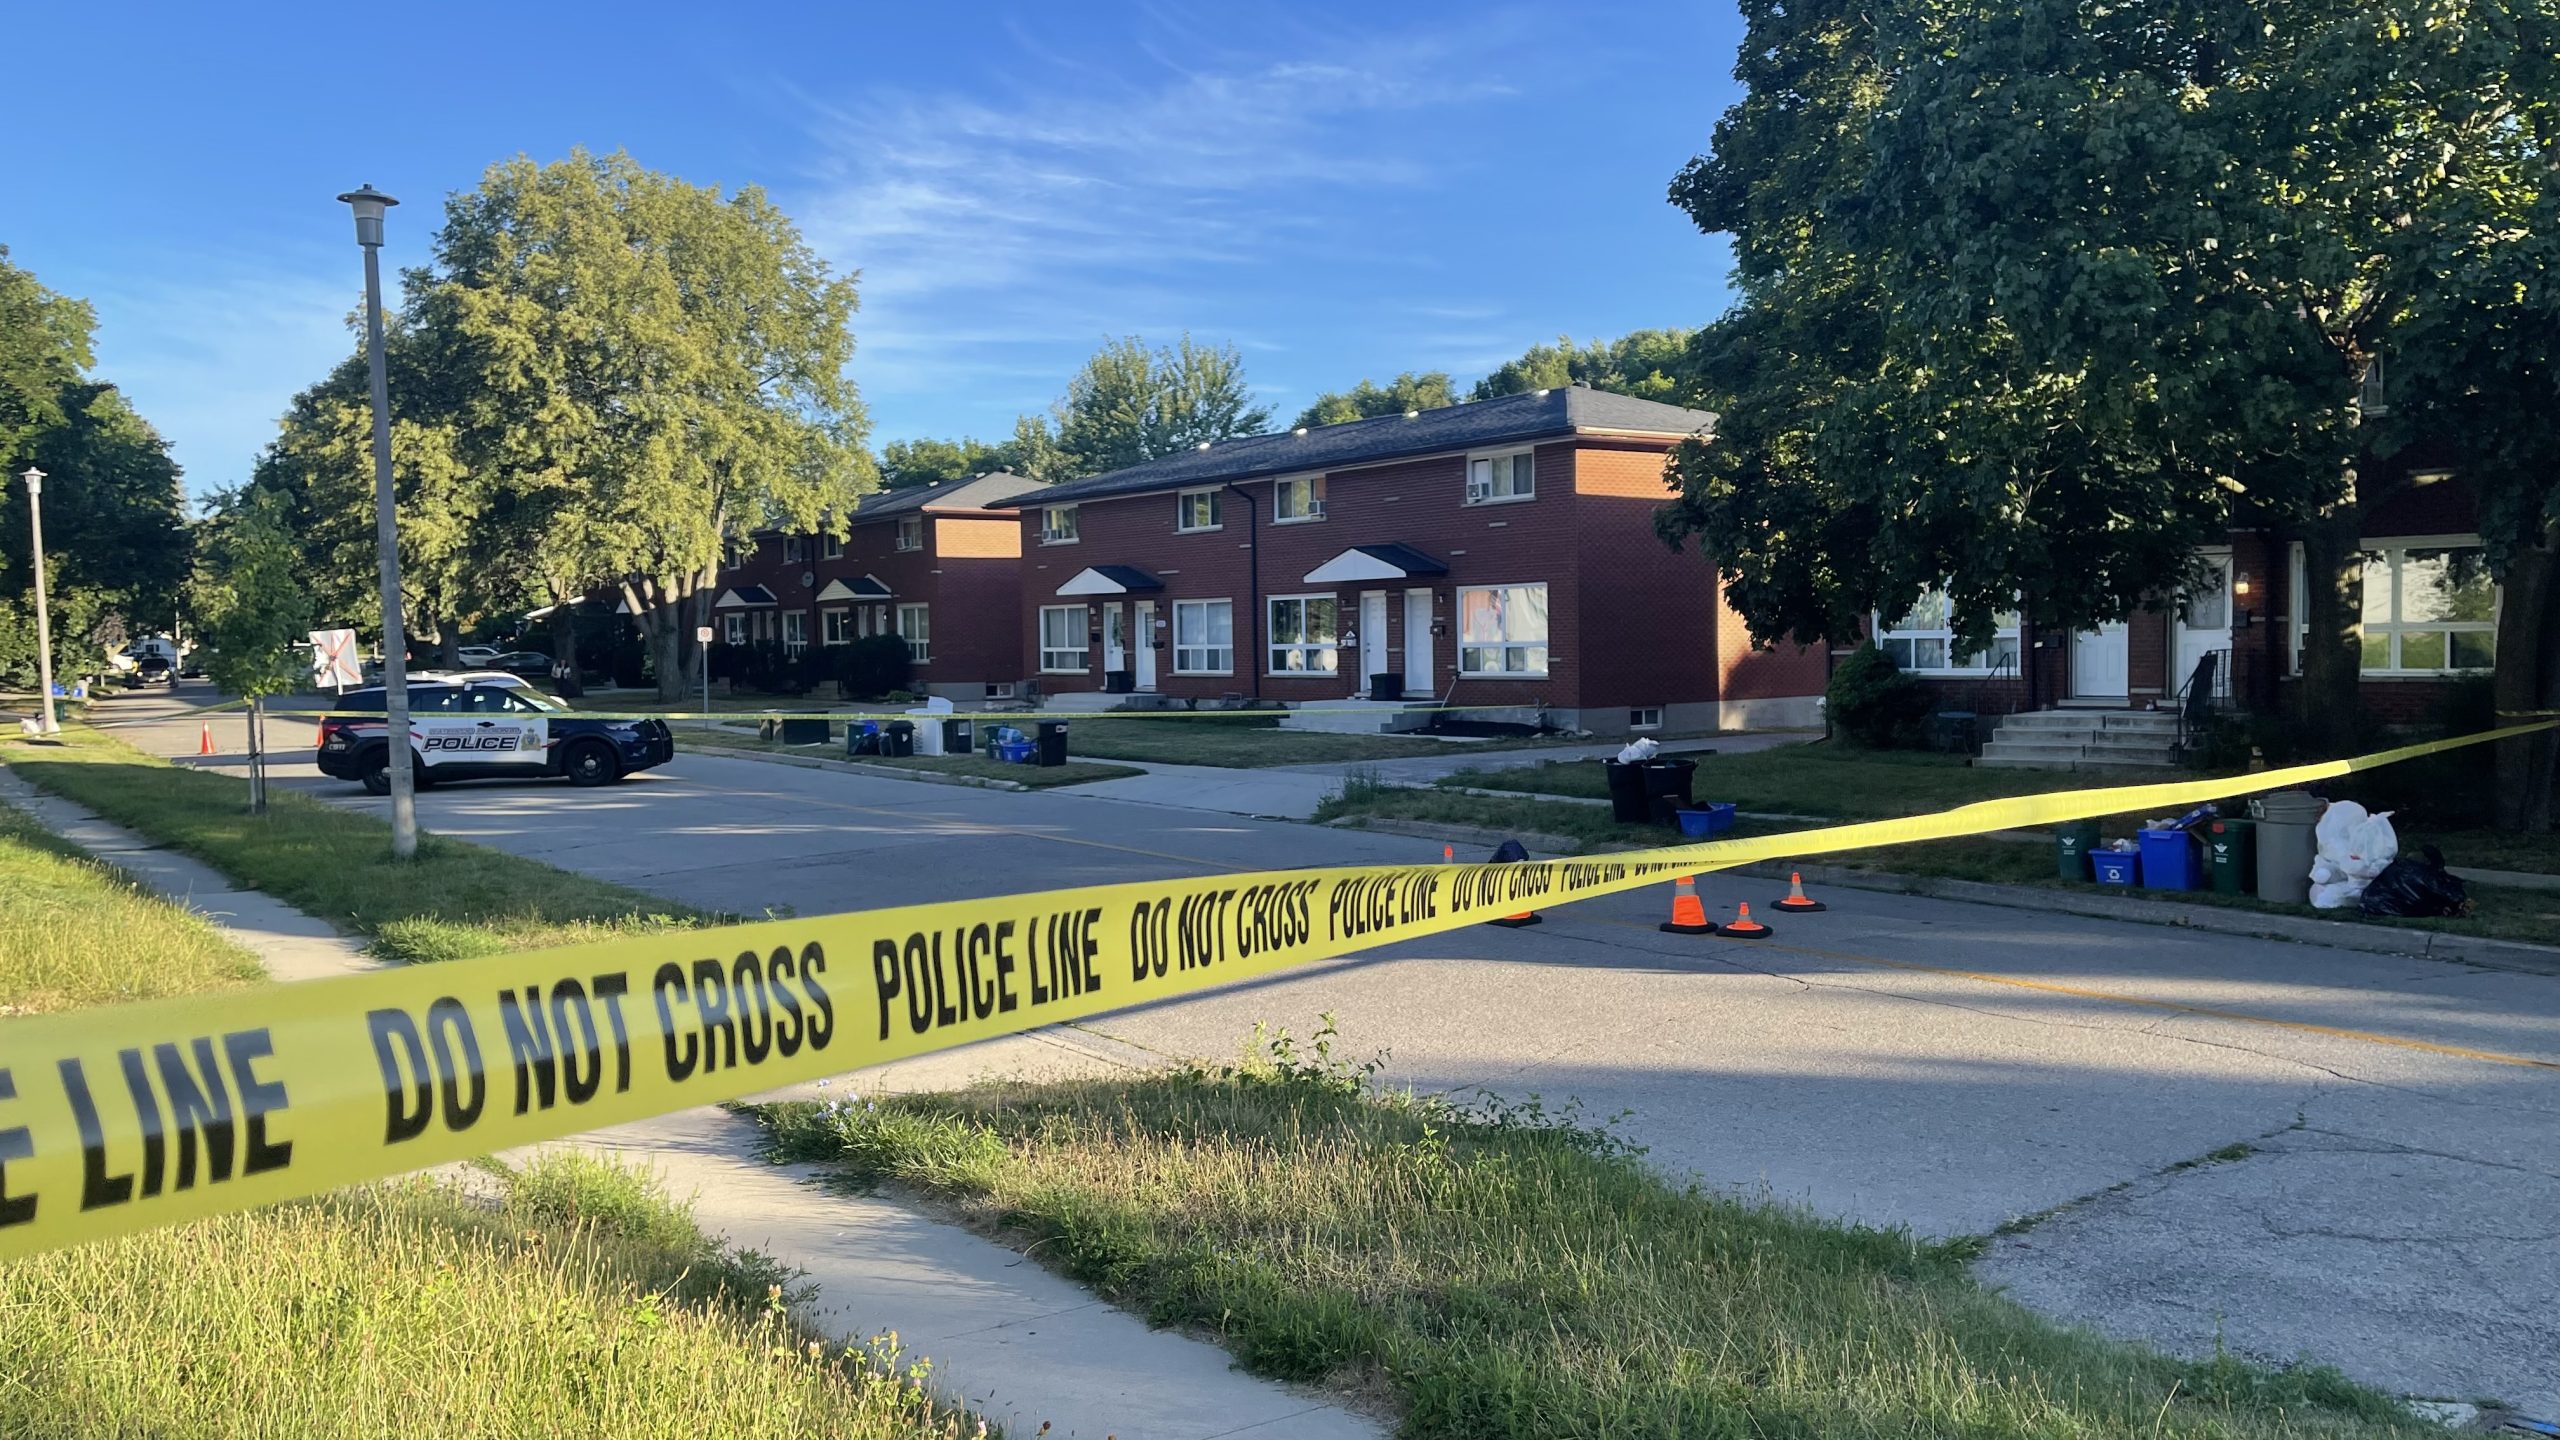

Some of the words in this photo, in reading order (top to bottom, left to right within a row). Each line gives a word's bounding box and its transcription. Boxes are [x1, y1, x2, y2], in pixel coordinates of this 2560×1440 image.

[421, 735, 519, 752] POLICE
[59, 1030, 292, 1212] LINE
[368, 997, 485, 1145] DO
[500, 972, 630, 1116] NOT
[654, 941, 834, 1082] CROSS
[873, 919, 1017, 1041] POLICE
[1028, 907, 1102, 1005] LINE
[1131, 896, 1171, 982] DO
[1178, 889, 1238, 971] NOT
[1237, 878, 1321, 958] CROSS
[1329, 871, 1405, 941] POLICE
[1401, 868, 1447, 924] LINE
[1452, 865, 1482, 912] DO
[1477, 865, 1510, 907] NOT
[1509, 864, 1553, 901] CROSS
